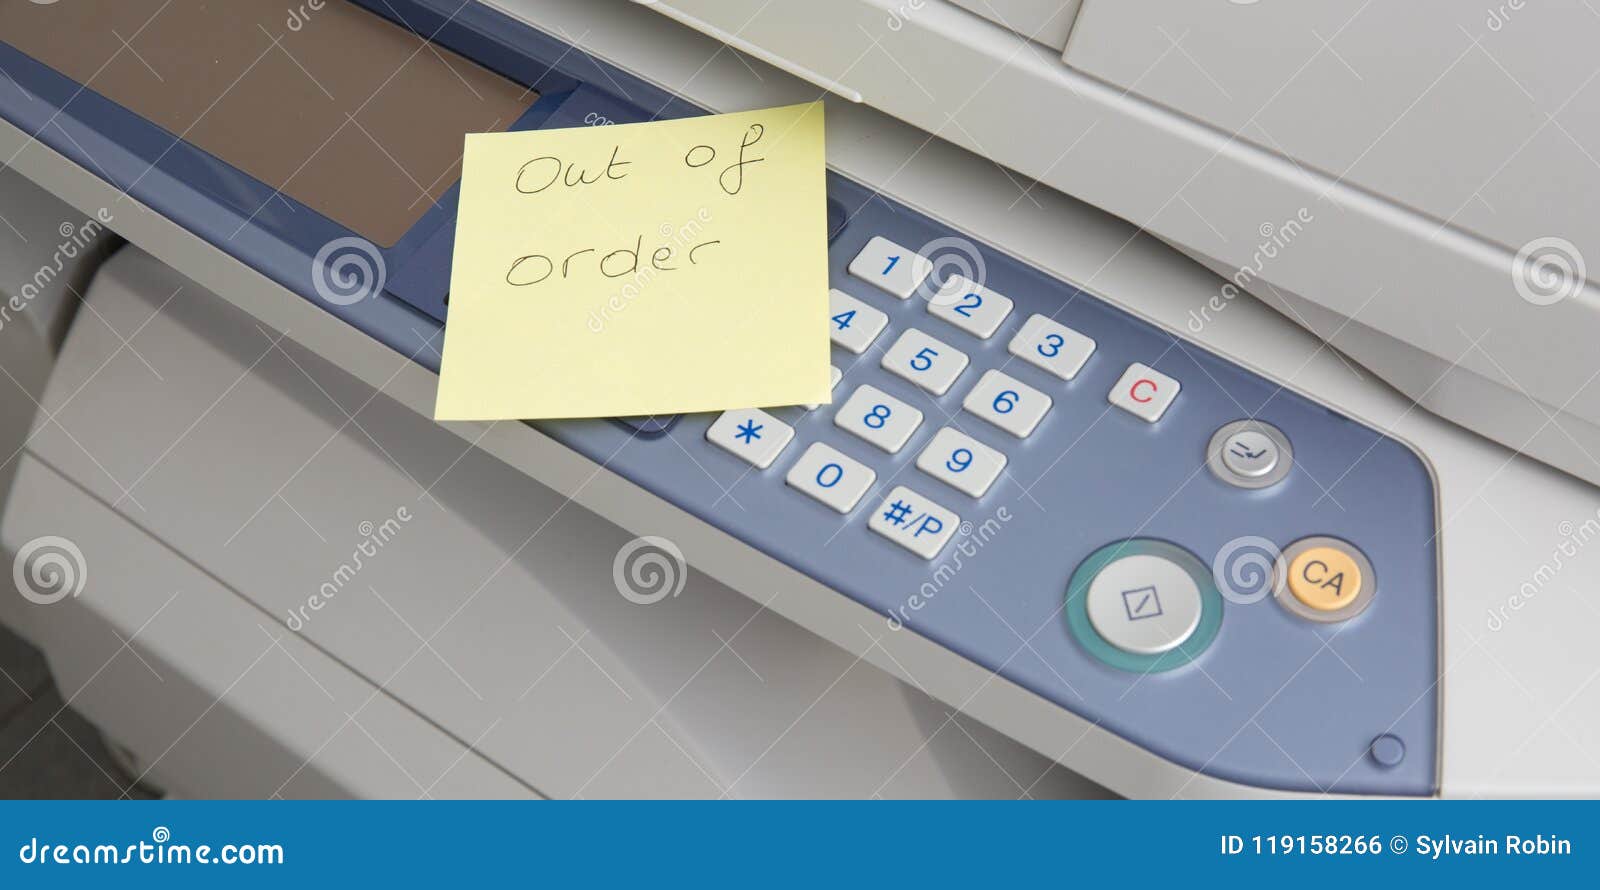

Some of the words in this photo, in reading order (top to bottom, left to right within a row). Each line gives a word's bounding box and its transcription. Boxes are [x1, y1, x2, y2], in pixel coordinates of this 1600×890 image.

[515, 146, 633, 194] Out
[685, 124, 765, 195] of
[506, 235, 721, 287] order
[882, 255, 900, 276] 1
[954, 293, 983, 317] 2
[831, 310, 856, 330] 4
[1037, 334, 1065, 358] 3
[910, 347, 938, 372] 5
[992, 390, 1020, 414] 6
[1129, 378, 1158, 403] C
[863, 404, 891, 429] 8
[946, 448, 973, 473] 9
[884, 500, 943, 537] #/P
[1302, 560, 1344, 597] CA
